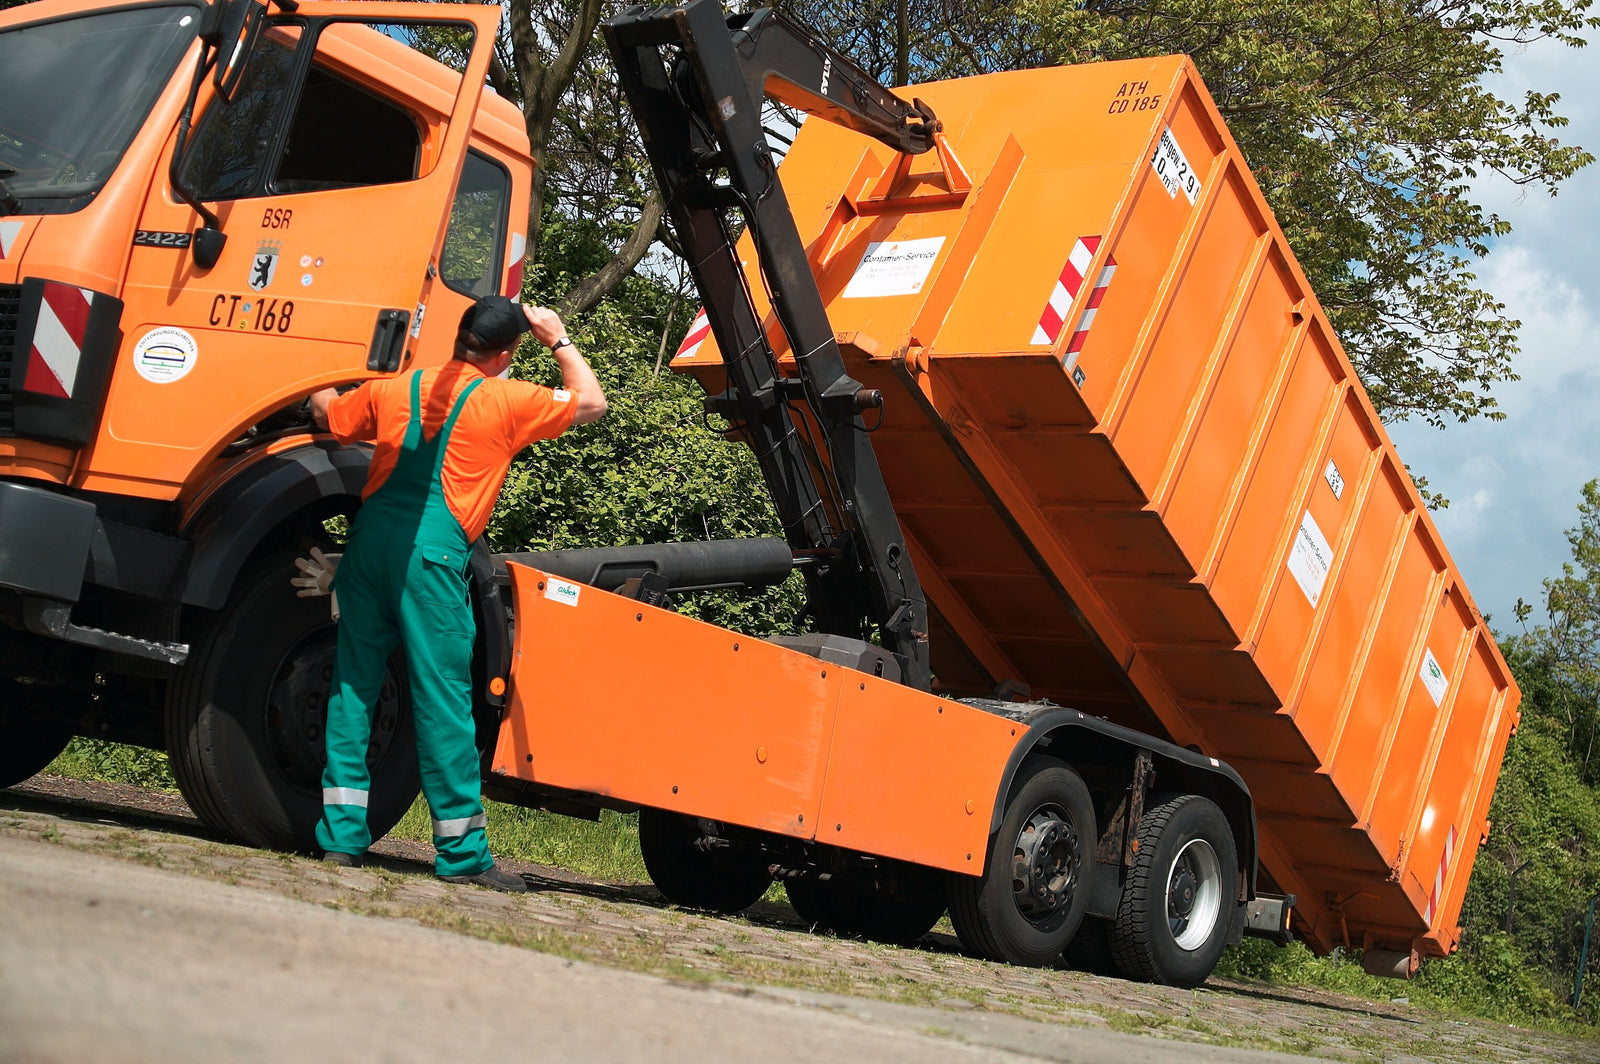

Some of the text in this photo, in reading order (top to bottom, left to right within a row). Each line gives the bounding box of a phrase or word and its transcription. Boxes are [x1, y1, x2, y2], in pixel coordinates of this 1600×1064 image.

[1116, 81, 1149, 97] ATH
[1108, 95, 1162, 114] CD 185
[1161, 130, 1180, 169] eergew.
[261, 208, 292, 229] BSR
[135, 231, 190, 246] 2422
[209, 294, 294, 333] CT 168
